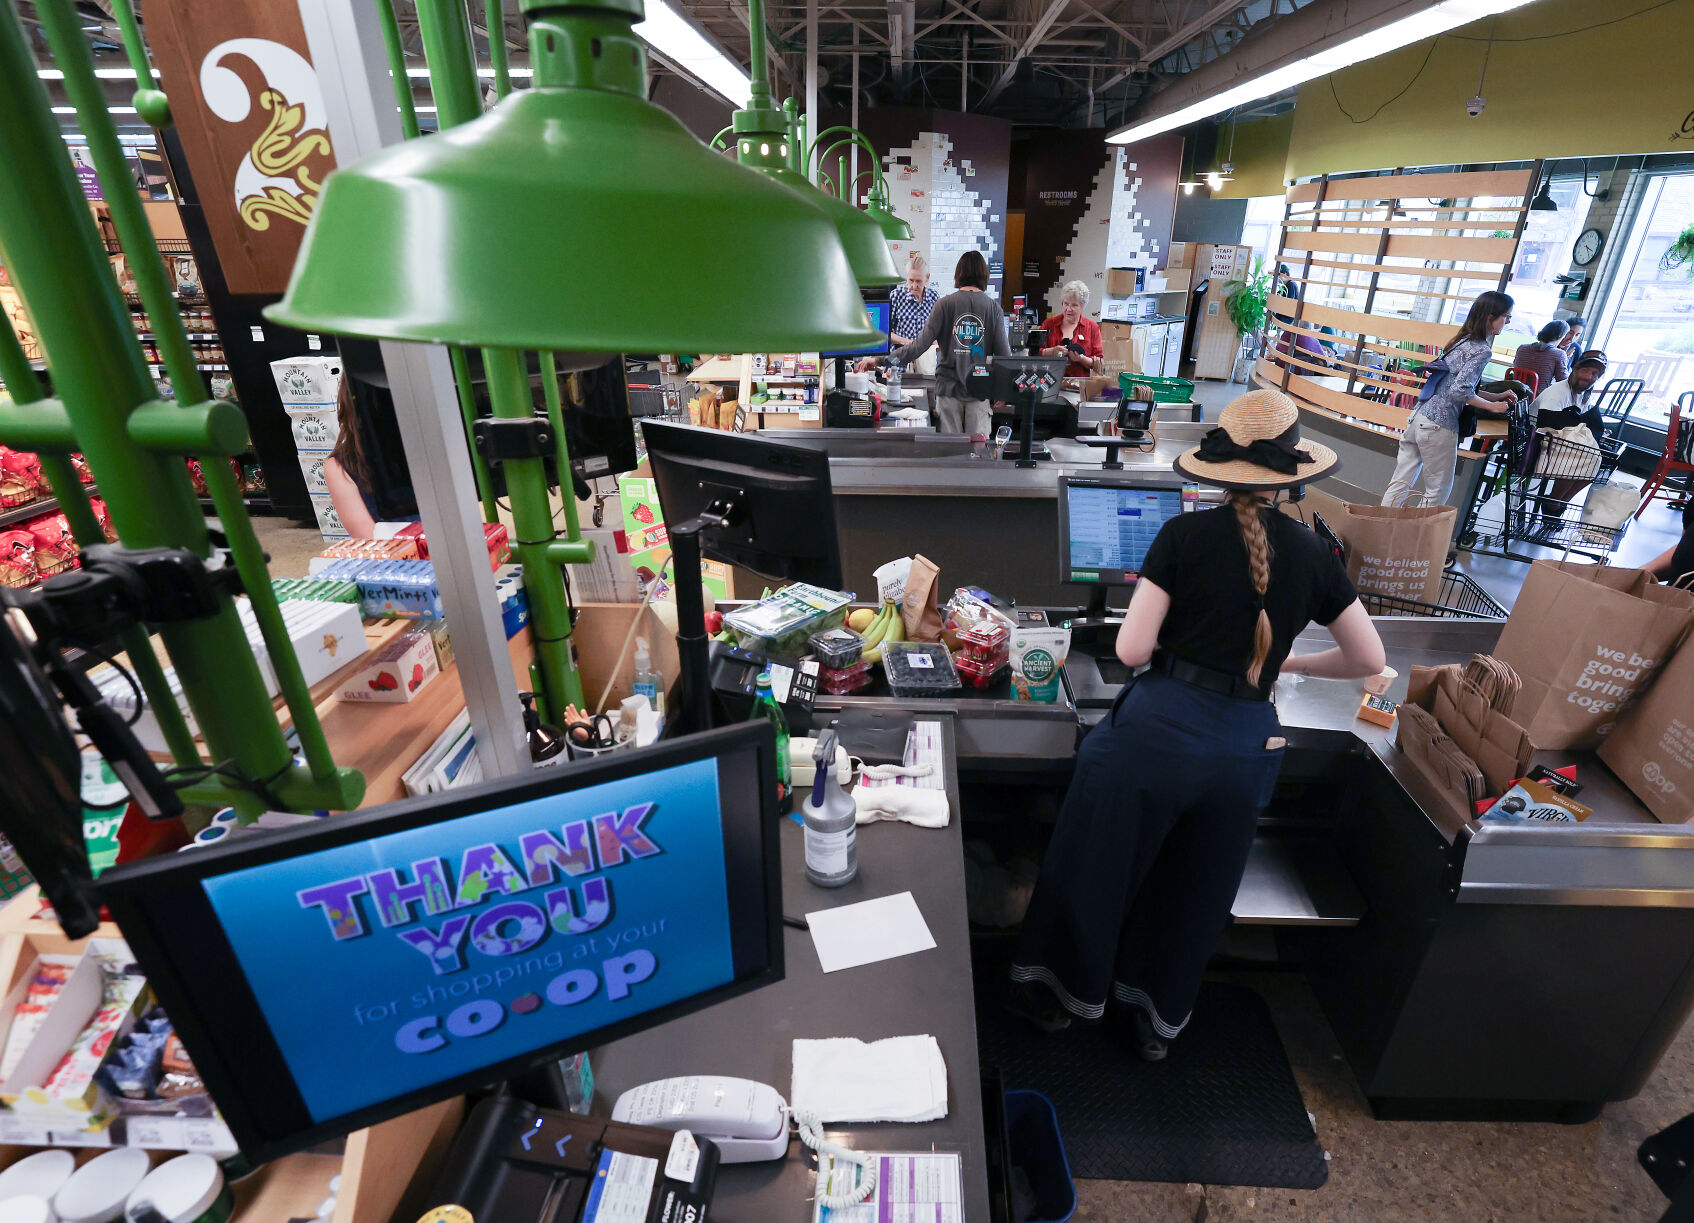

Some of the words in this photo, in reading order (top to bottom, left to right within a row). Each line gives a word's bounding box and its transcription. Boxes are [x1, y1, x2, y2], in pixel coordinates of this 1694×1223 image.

[1040, 191, 1078, 199] RESTROOMS
[283, 368, 312, 384] MOUNTAIN
[299, 416, 327, 430] MOUNTAIN
[310, 461, 325, 475] MOUN
[1362, 555, 1382, 566] we
[1385, 557, 1431, 568] believe
[1360, 566, 1395, 577] good
[1398, 568, 1429, 578] food
[882, 578, 902, 594] purely
[1357, 576, 1405, 593] brings
[1409, 582, 1426, 590] us
[799, 583, 839, 604] Earthbound
[418, 642, 433, 659] GLEE
[1596, 644, 1626, 663] we
[1584, 660, 1640, 681] good
[343, 691, 372, 700] GLEE
[296, 801, 662, 942] THANK
[396, 876, 611, 976] YOU
[354, 1002, 399, 1026] for
[411, 951, 563, 1008] shopping
[573, 939, 599, 958] at
[607, 917, 669, 949] your
